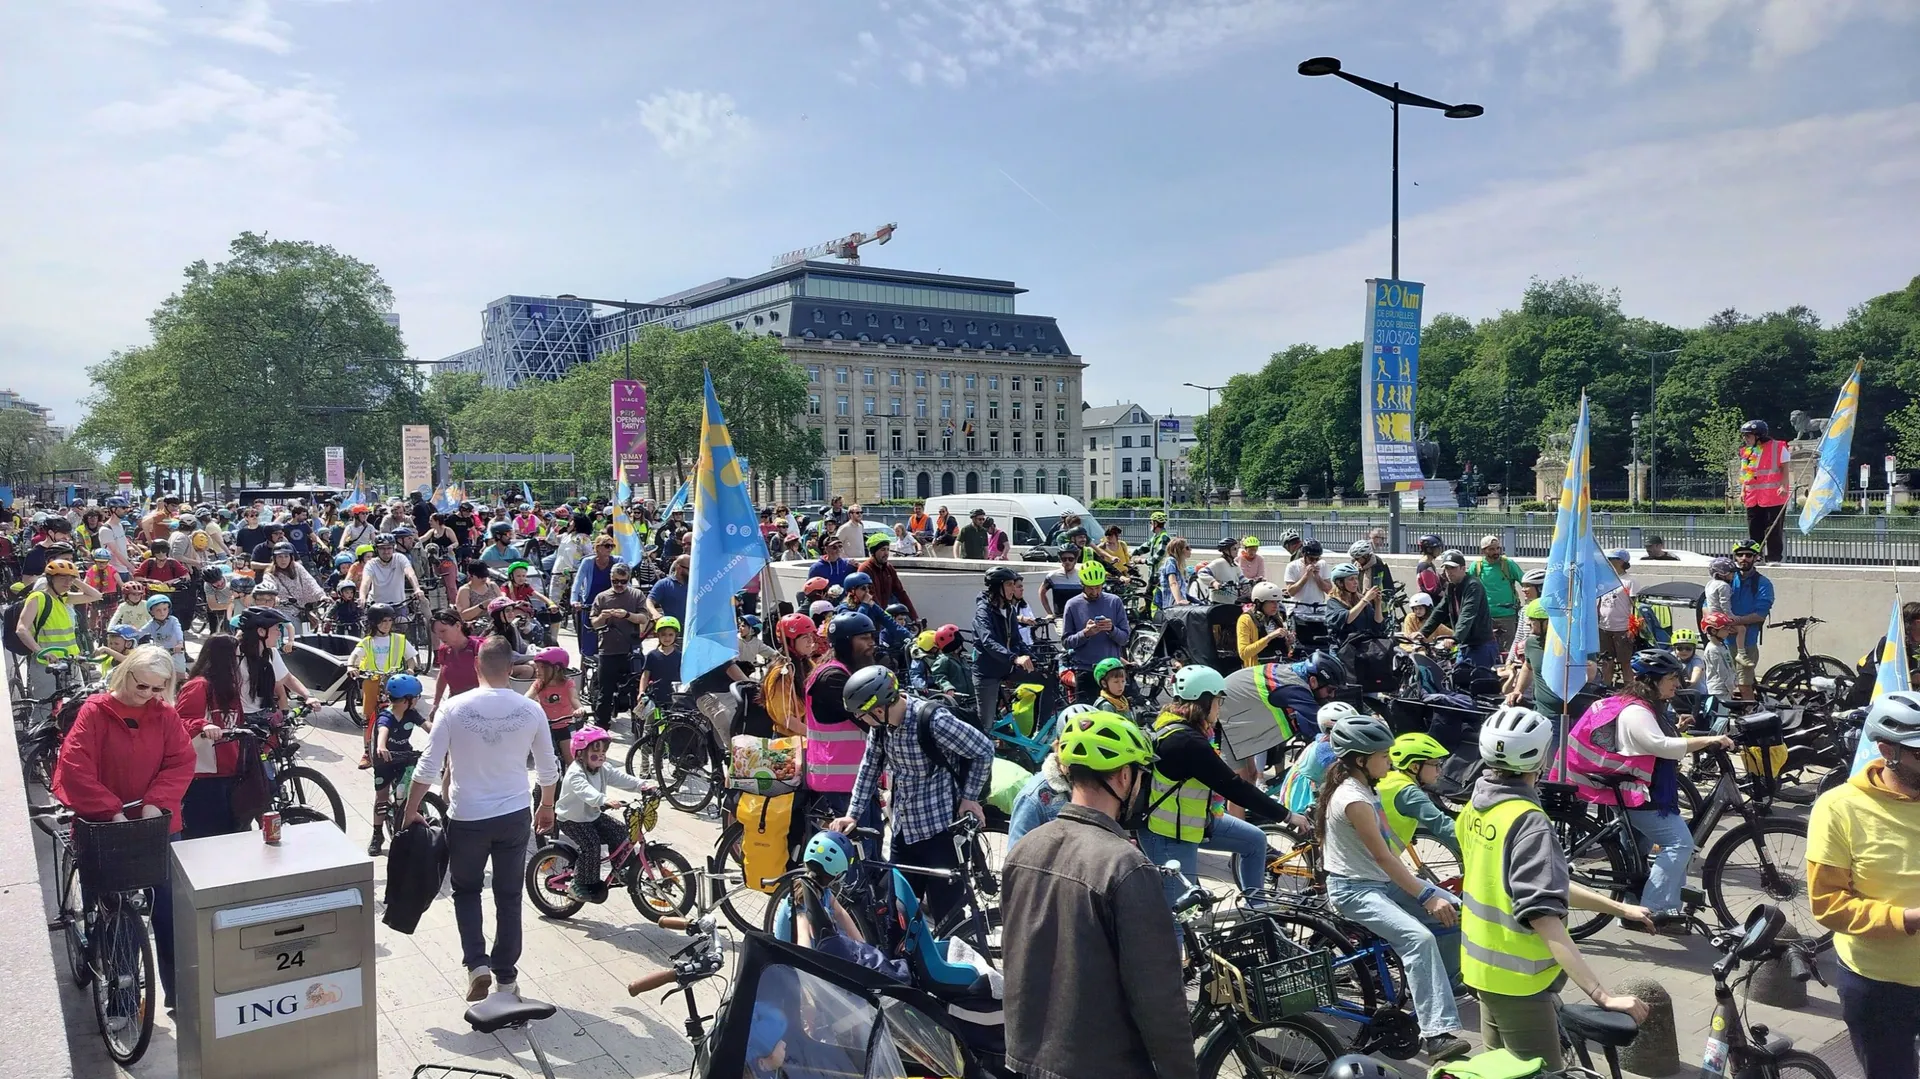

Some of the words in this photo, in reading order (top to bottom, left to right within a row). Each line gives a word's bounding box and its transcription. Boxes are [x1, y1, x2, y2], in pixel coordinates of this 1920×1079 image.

[1378, 283, 1401, 308] 20
[1402, 286, 1419, 310] km
[1385, 310, 1414, 320] BRUXELLES
[1376, 320, 1394, 328] DOOR
[1396, 320, 1416, 330] BRUSSEL
[1376, 329, 1416, 346] 31/05/26
[276, 950, 305, 970] 24
[236, 995, 300, 1026] ING
